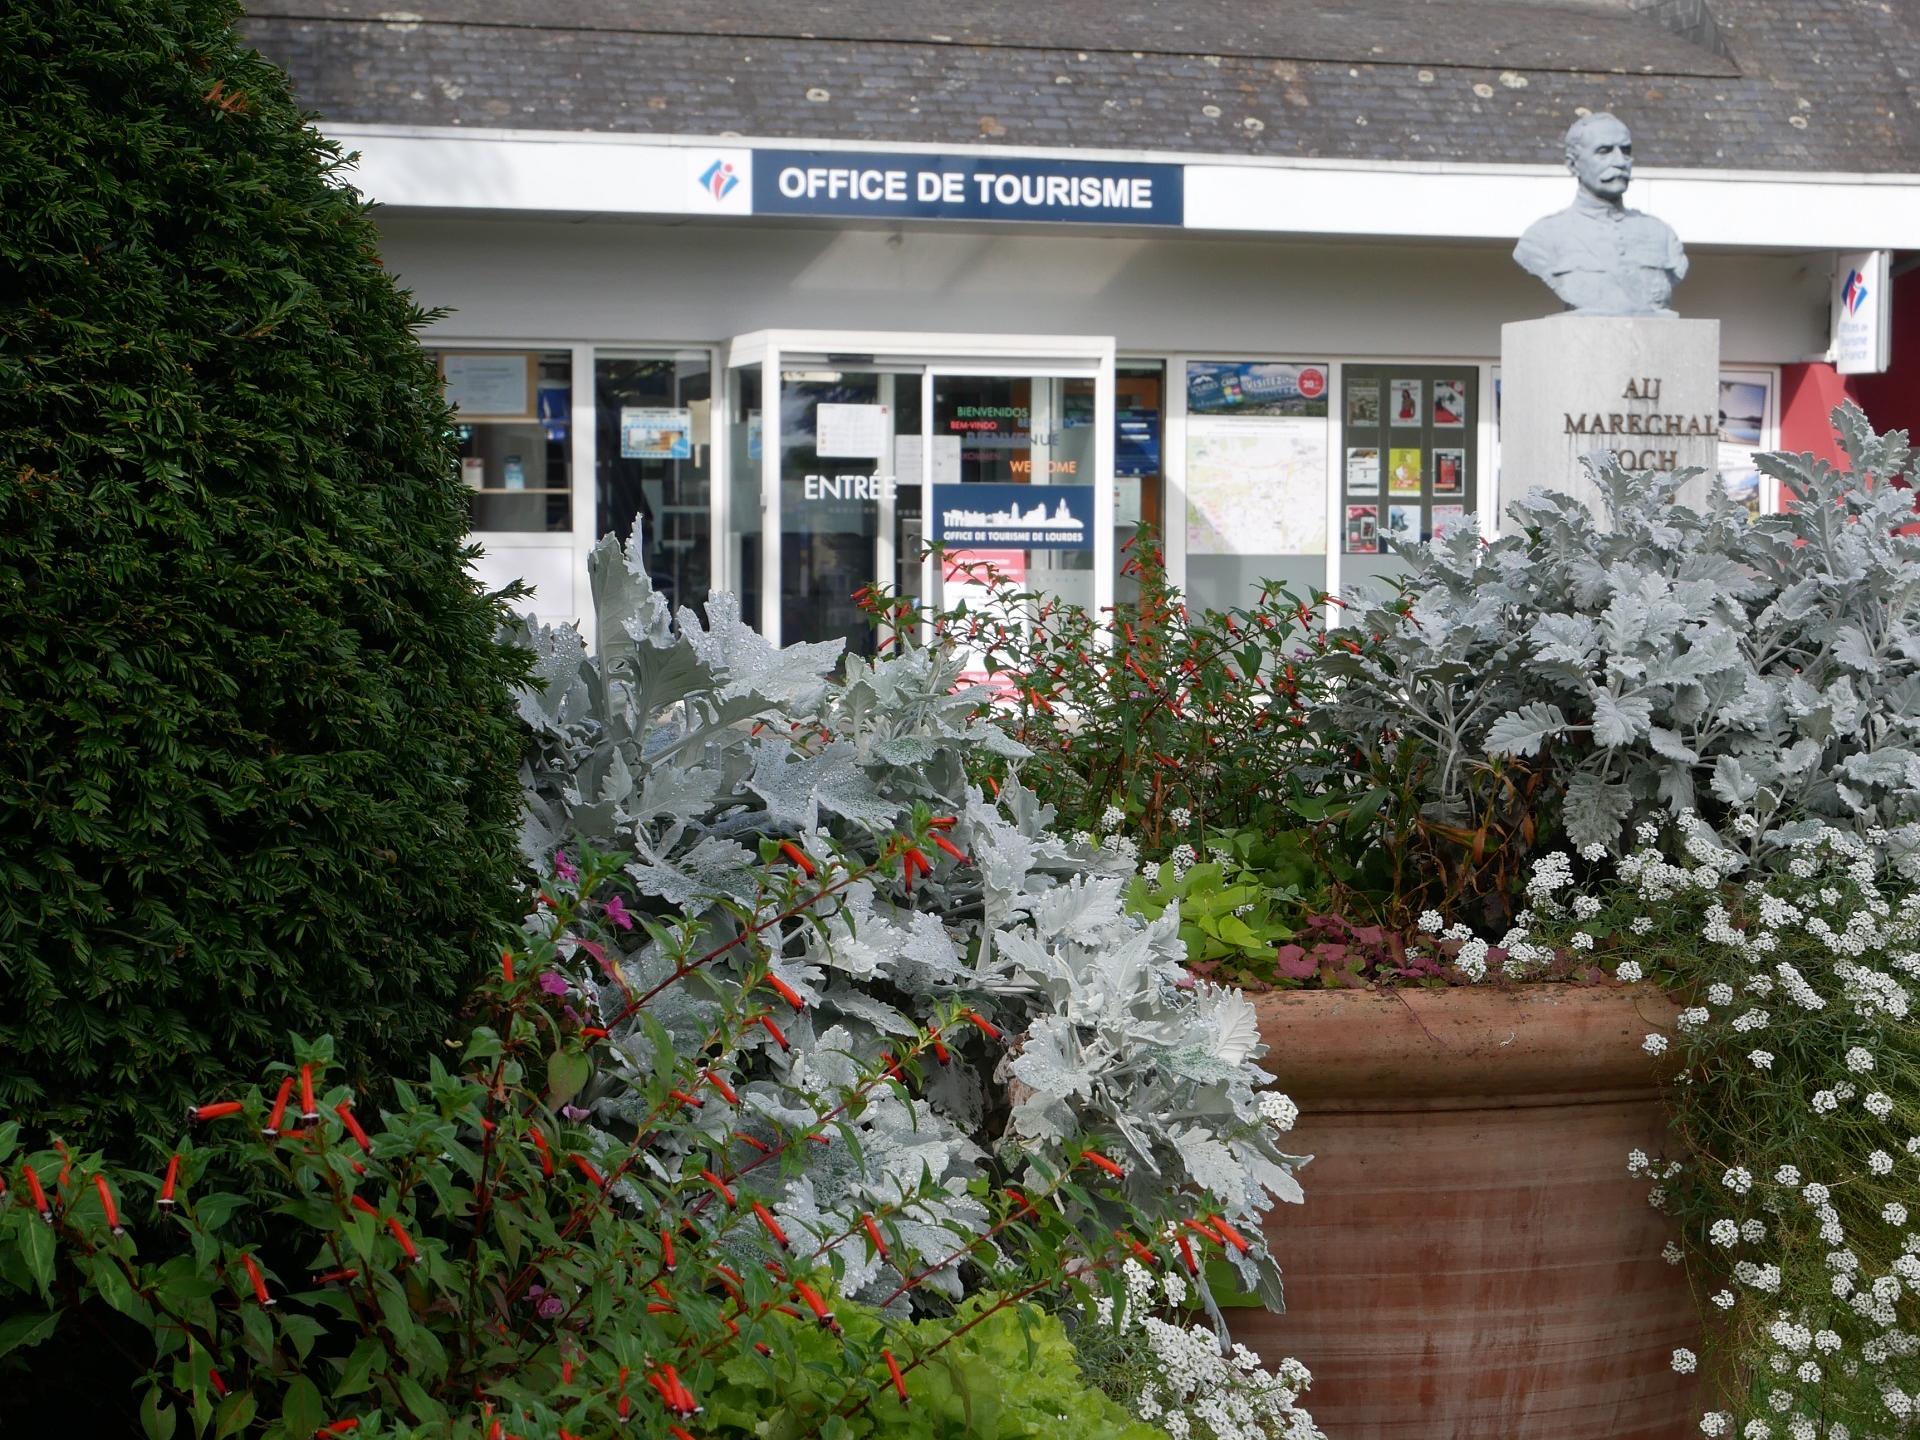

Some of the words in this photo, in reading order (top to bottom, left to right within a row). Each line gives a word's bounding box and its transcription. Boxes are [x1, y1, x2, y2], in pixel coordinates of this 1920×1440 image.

[778, 167, 907, 201] OFFICE
[917, 171, 965, 203] DE
[974, 174, 1153, 209] TOURISME
[1622, 377, 1662, 400] AU
[957, 406, 1029, 418] BIENVENIDOS
[1564, 413, 1719, 436] MARECHAL
[1611, 449, 1678, 471] OCH
[804, 469, 898, 500] ENTRÉE
[943, 531, 973, 541] OFFICE
[975, 532, 986, 541] DE
[988, 531, 1030, 542] TOURISME
[1032, 532, 1043, 541] DE
[1045, 532, 1084, 542] LOURDES
